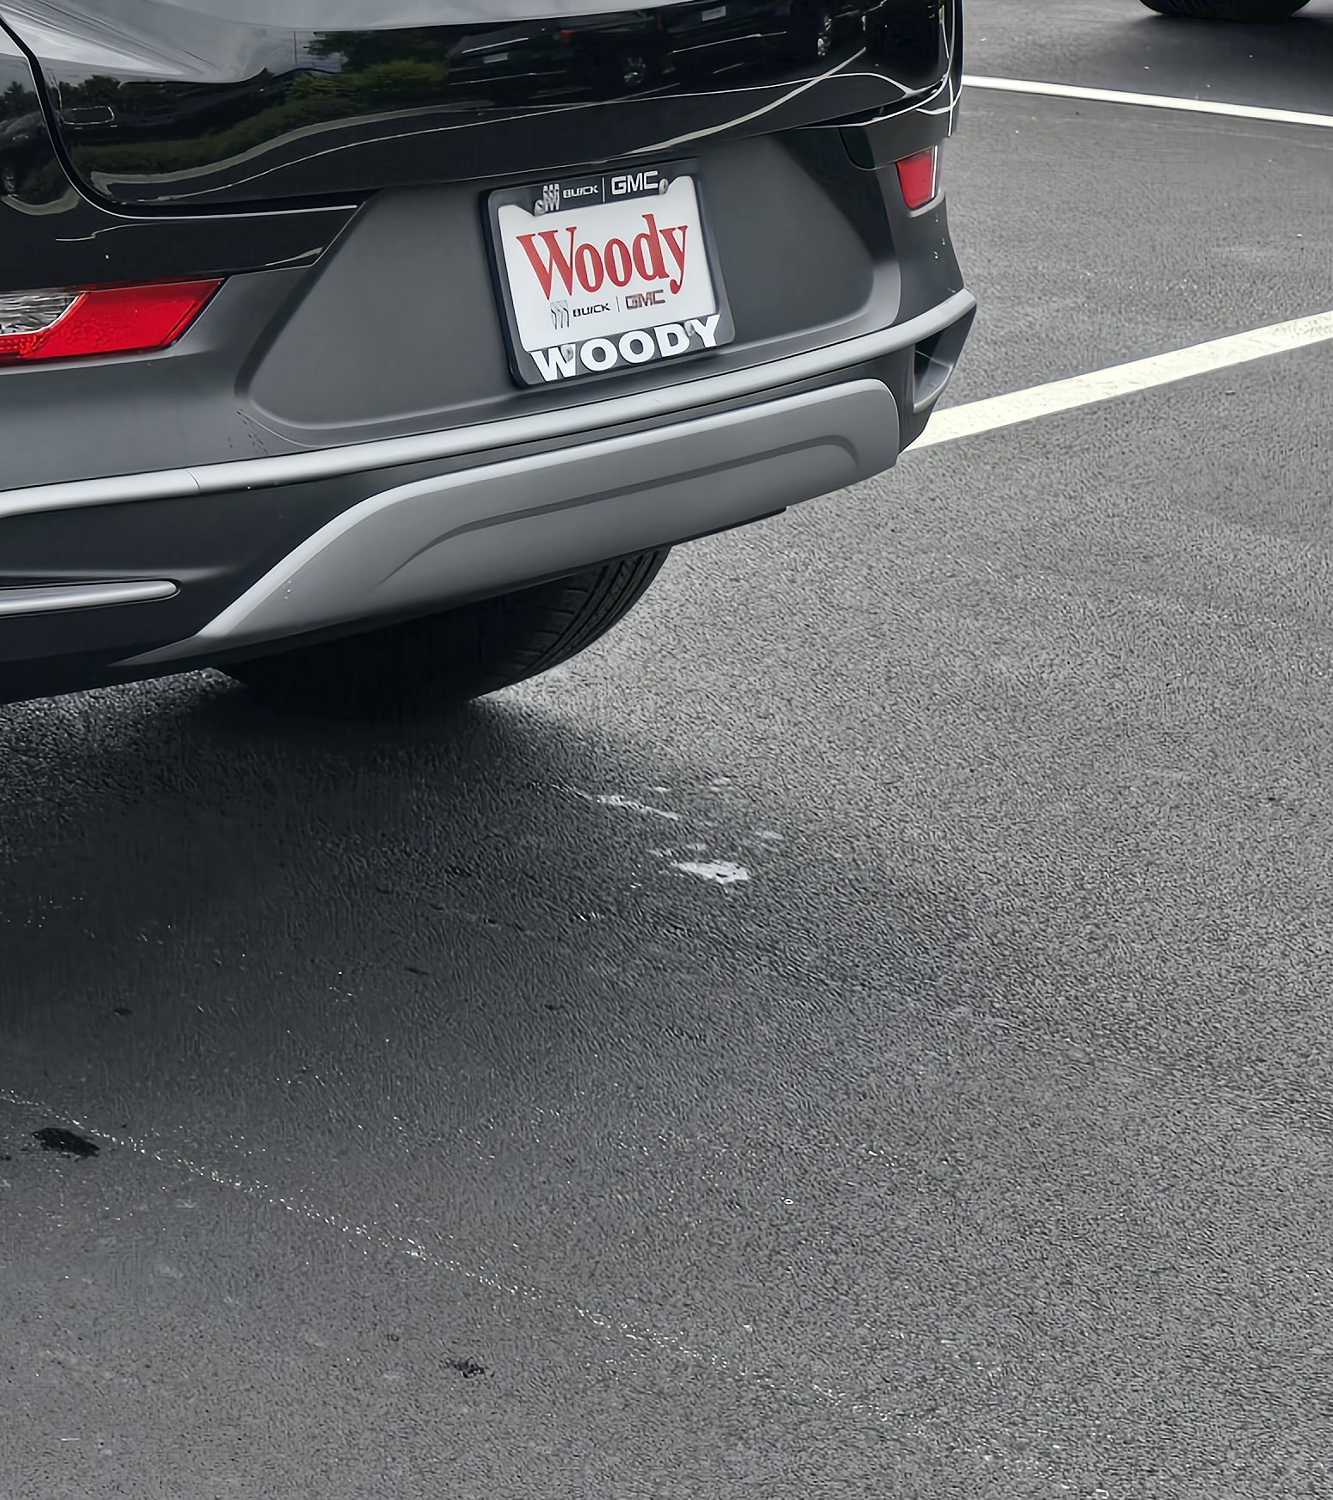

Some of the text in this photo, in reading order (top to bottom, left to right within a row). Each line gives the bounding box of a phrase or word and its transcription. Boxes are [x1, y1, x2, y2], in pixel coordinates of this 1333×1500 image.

[563, 171, 658, 199] BUICK GMC
[516, 213, 688, 300] Woody
[572, 289, 666, 317] BUICK GMC
[530, 314, 720, 382] WOODY
